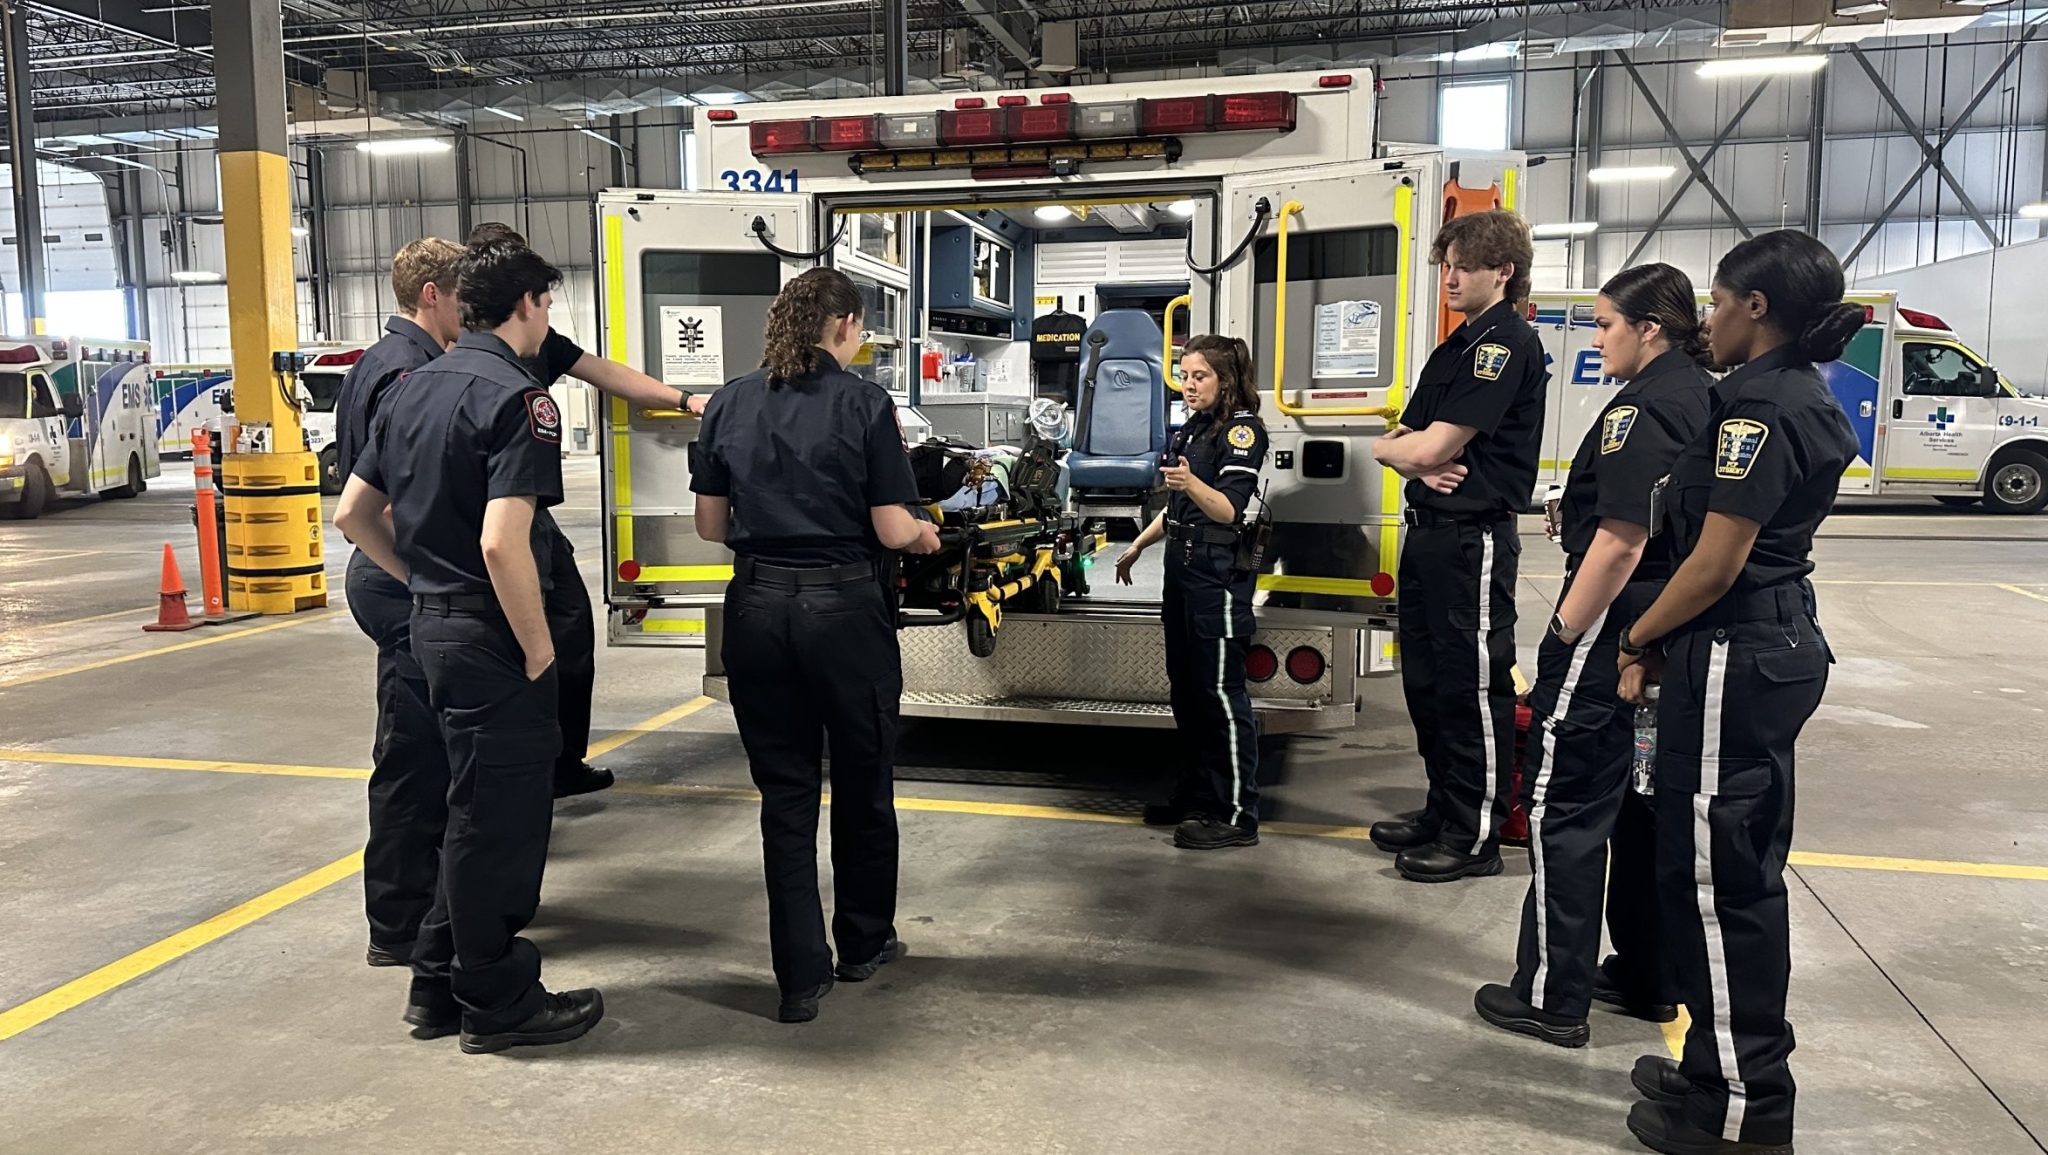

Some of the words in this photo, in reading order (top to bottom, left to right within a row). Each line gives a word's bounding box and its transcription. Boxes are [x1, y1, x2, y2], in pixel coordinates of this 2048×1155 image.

[720, 169, 798, 192] 3341
[1036, 332, 1081, 342] MEDICATION
[122, 383, 140, 409] EMS
[2004, 415, 2038, 427] 9-1-1
[1233, 448, 1248, 456] EMS
[1718, 466, 1745, 475] STUDENT
